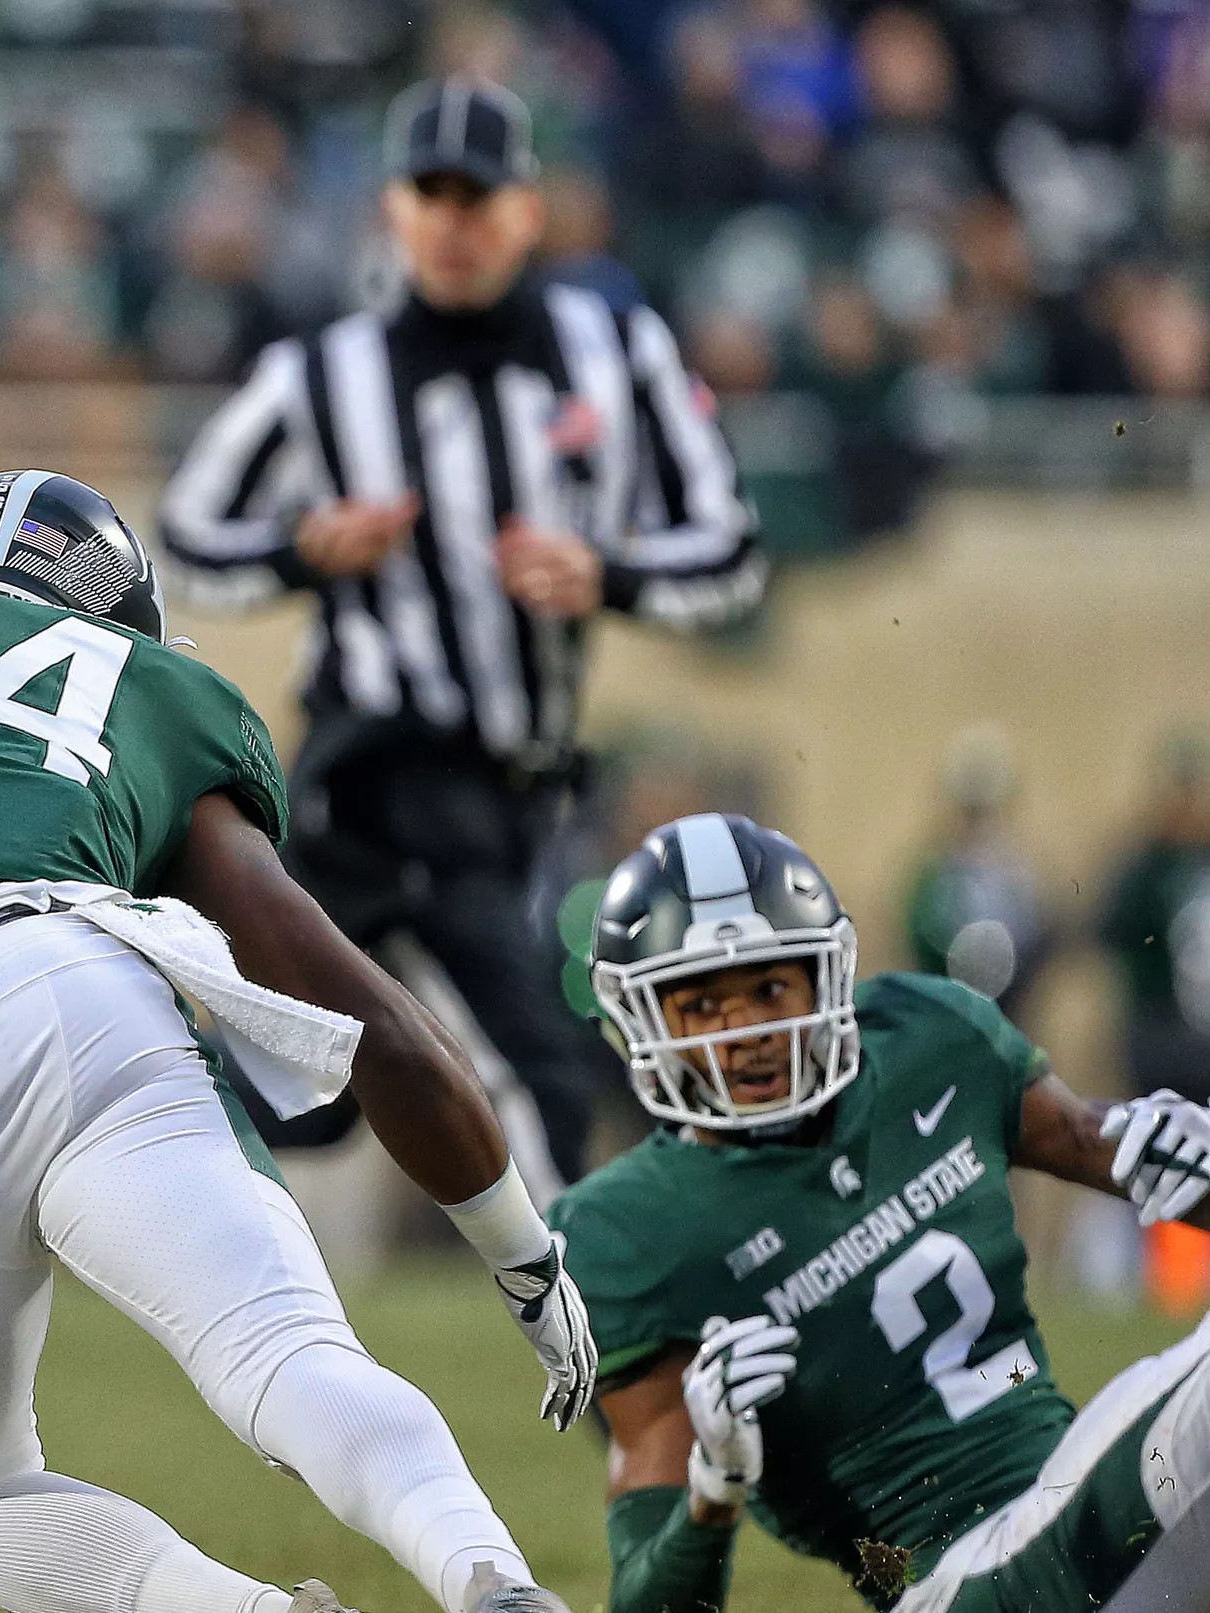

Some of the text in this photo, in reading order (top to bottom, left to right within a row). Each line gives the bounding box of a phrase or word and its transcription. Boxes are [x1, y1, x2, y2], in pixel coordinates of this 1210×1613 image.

[762, 1135, 987, 1326] MICHIGAN STATE
[870, 1228, 1038, 1424] 2
